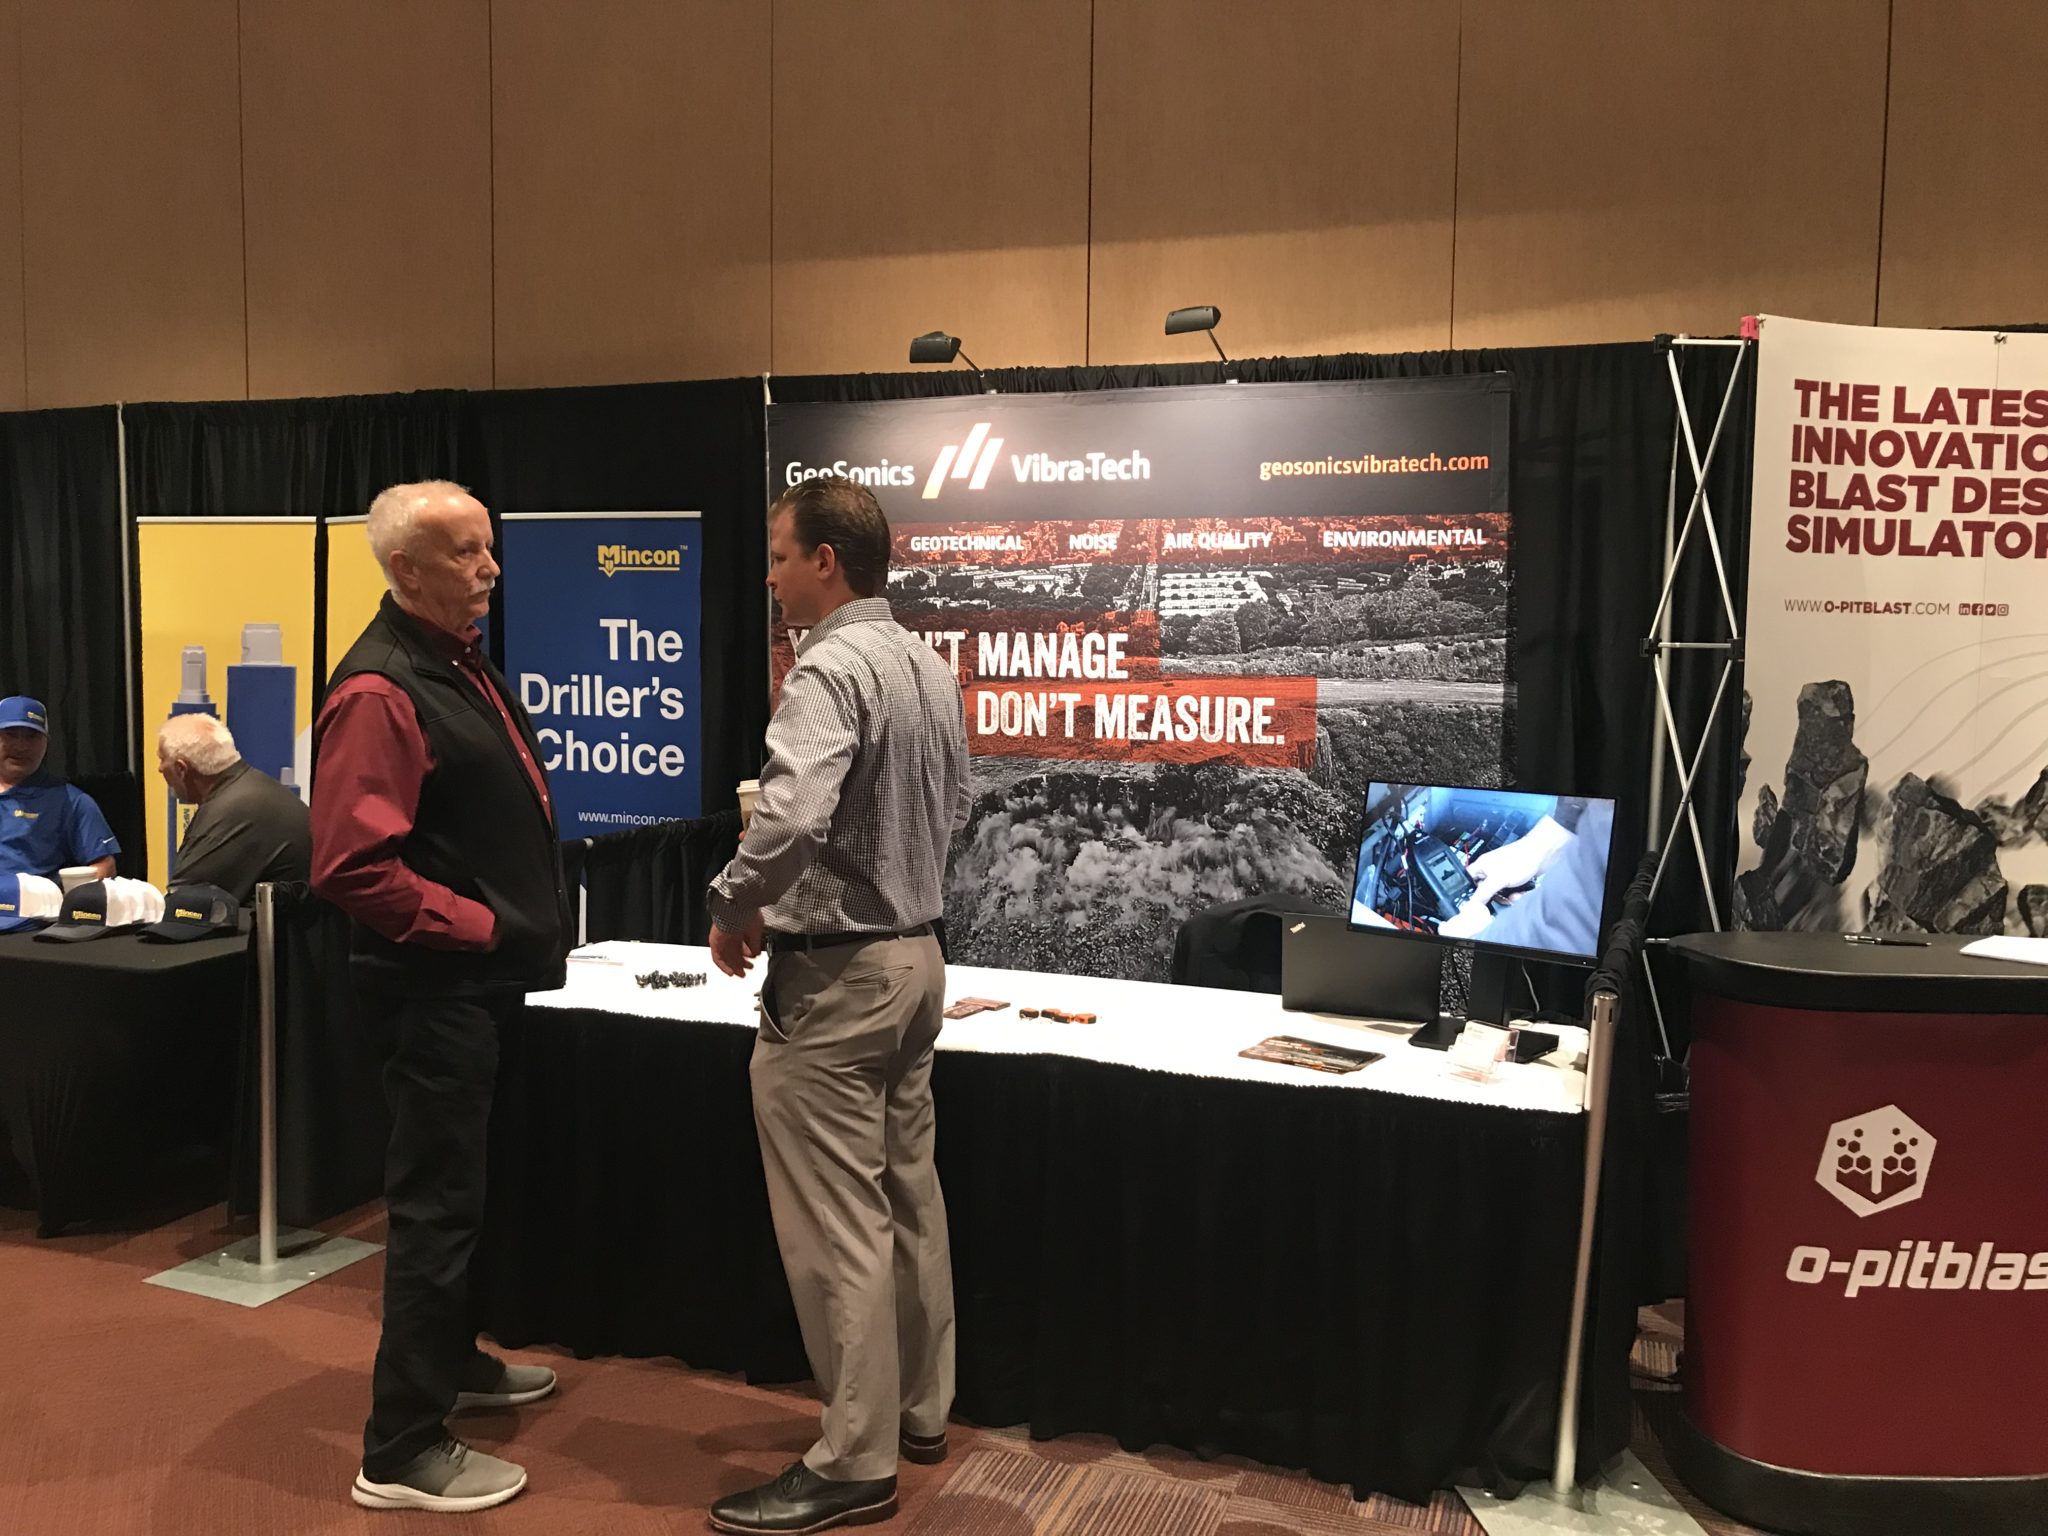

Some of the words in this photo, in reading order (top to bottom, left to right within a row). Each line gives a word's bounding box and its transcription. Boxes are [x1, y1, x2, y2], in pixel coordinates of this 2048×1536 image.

[1794, 378, 1880, 422] THE
[1893, 386, 2048, 428] LATES
[1259, 452, 1489, 481] geosonicsvibratech.com
[1791, 424, 2048, 472] INNOVATIO
[1789, 469, 1939, 513] BLAST
[1952, 476, 2048, 516] DES
[598, 545, 680, 570] Mincon
[910, 535, 1025, 551] GEOTECHNICAL
[1069, 533, 1118, 550] NOISE
[1163, 533, 1194, 549] AIR
[1198, 531, 1273, 550] QUALITY
[1323, 528, 1487, 547] ENVIRONMENTAL
[1784, 599, 1951, 616] WWW.O-PITBLAST.COM
[600, 618, 684, 663] The
[978, 631, 1129, 679] MANAGE
[520, 672, 685, 720] Driller's
[977, 690, 1082, 738] DON'T
[1094, 694, 1286, 745] MEASURE.
[535, 728, 685, 777] Choice
